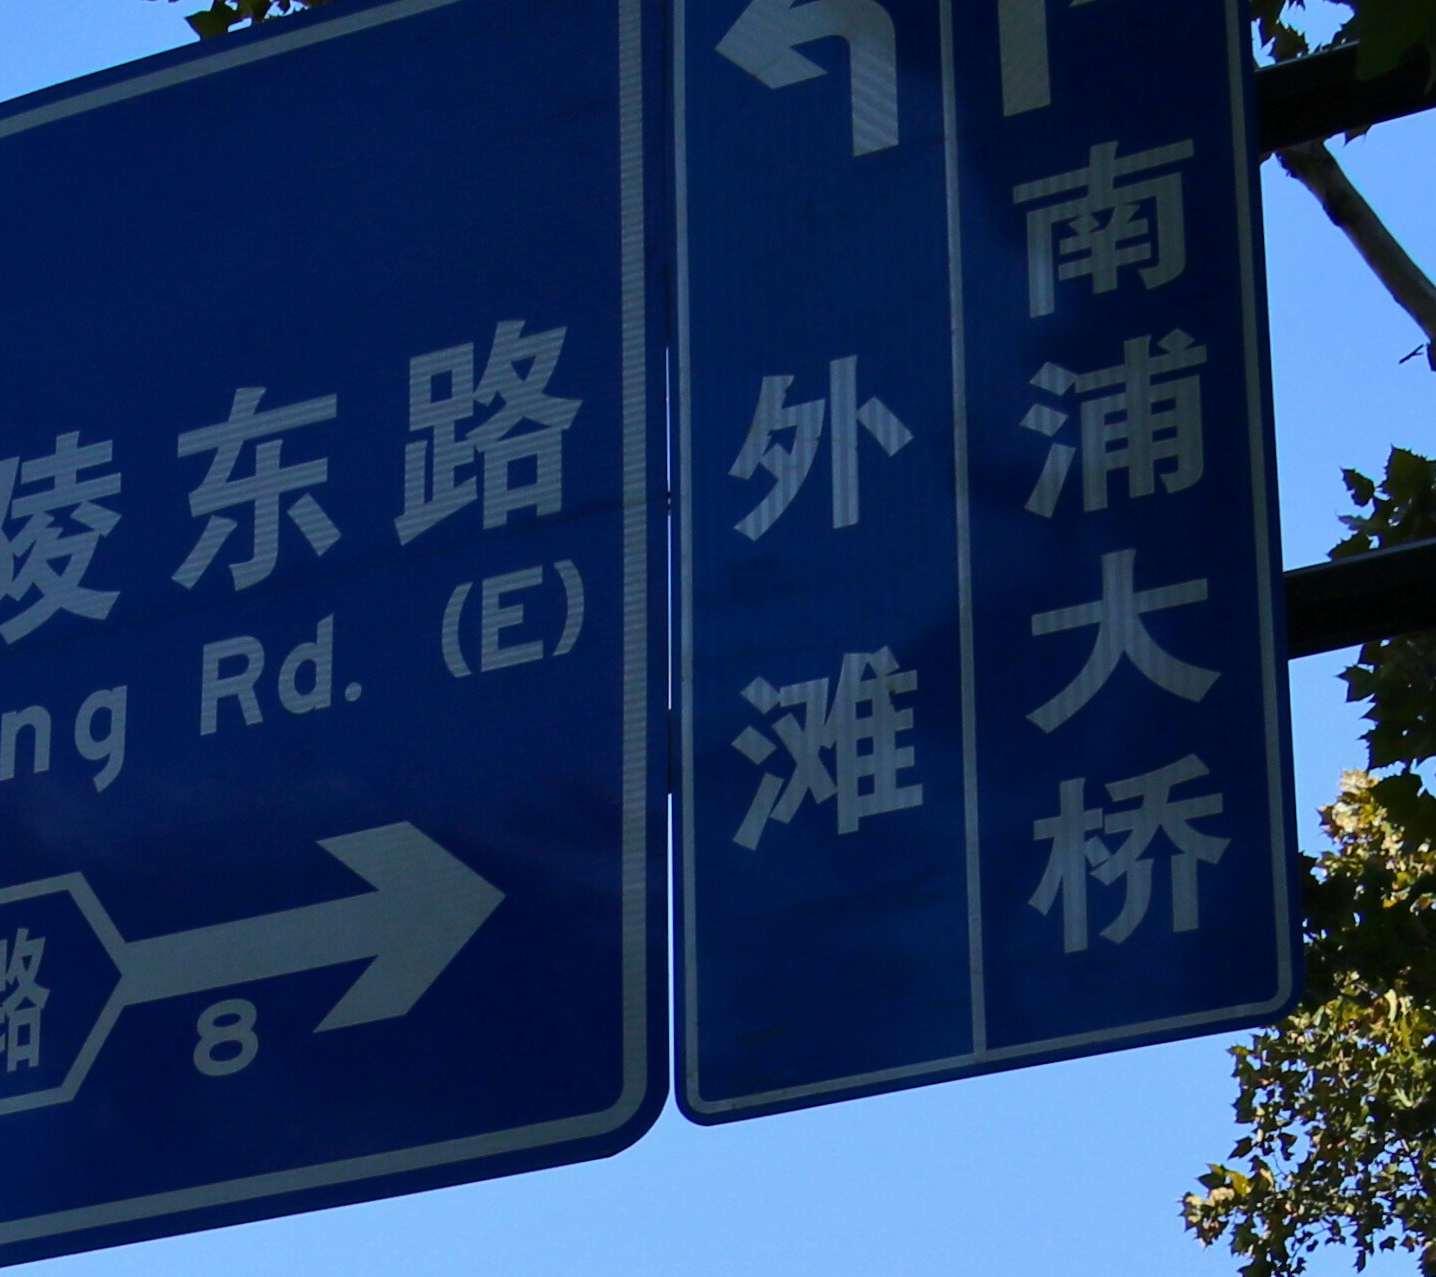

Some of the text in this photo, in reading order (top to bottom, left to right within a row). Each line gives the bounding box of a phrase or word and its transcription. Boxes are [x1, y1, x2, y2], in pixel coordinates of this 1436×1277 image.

[199, 613, 362, 736] Rd.
[442, 559, 585, 680] (E)
[728, 355, 923, 851] 外滩
[1013, 139, 1231, 954] 南浦大桥
[193, 1000, 257, 1075] 8
